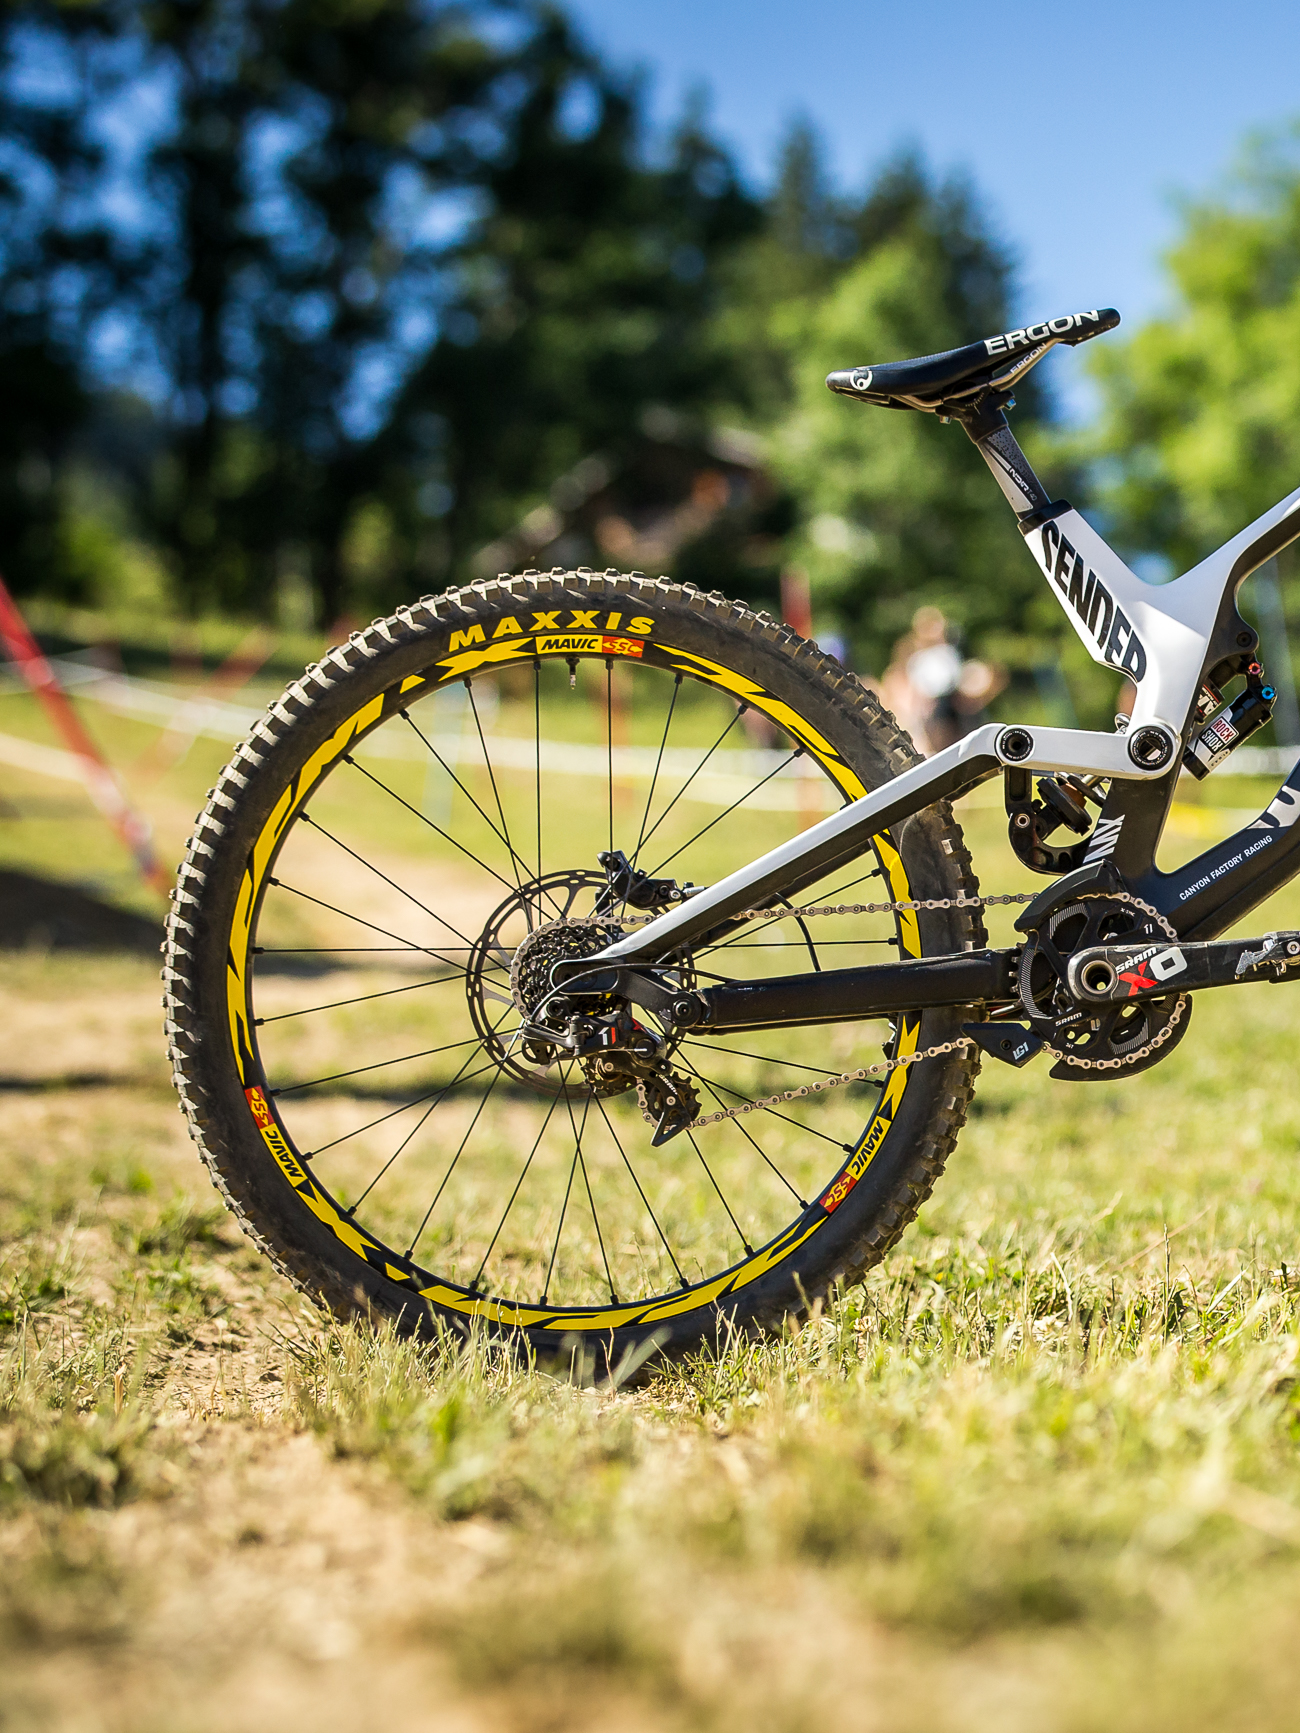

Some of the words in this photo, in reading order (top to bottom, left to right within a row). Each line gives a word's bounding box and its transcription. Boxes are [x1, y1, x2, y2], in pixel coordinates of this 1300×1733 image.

[983, 309, 1100, 356] ERGON
[1009, 342, 1047, 374] ERGON
[448, 610, 655, 652] MAXXIS
[541, 638, 599, 650] MAVIC
[1201, 729, 1224, 752] SHOX
[1211, 720, 1235, 741] ROCK
[1179, 876, 1211, 901] CANYON
[1210, 853, 1243, 880] FACTORY
[1243, 835, 1273, 857] RACING
[1115, 946, 1157, 974] SRAM
[1055, 1012, 1083, 1027] SRAM
[1012, 1041, 1029, 1060] LG1
[264, 1130, 304, 1178] MAVIC
[851, 1120, 884, 1175] MAVIC
